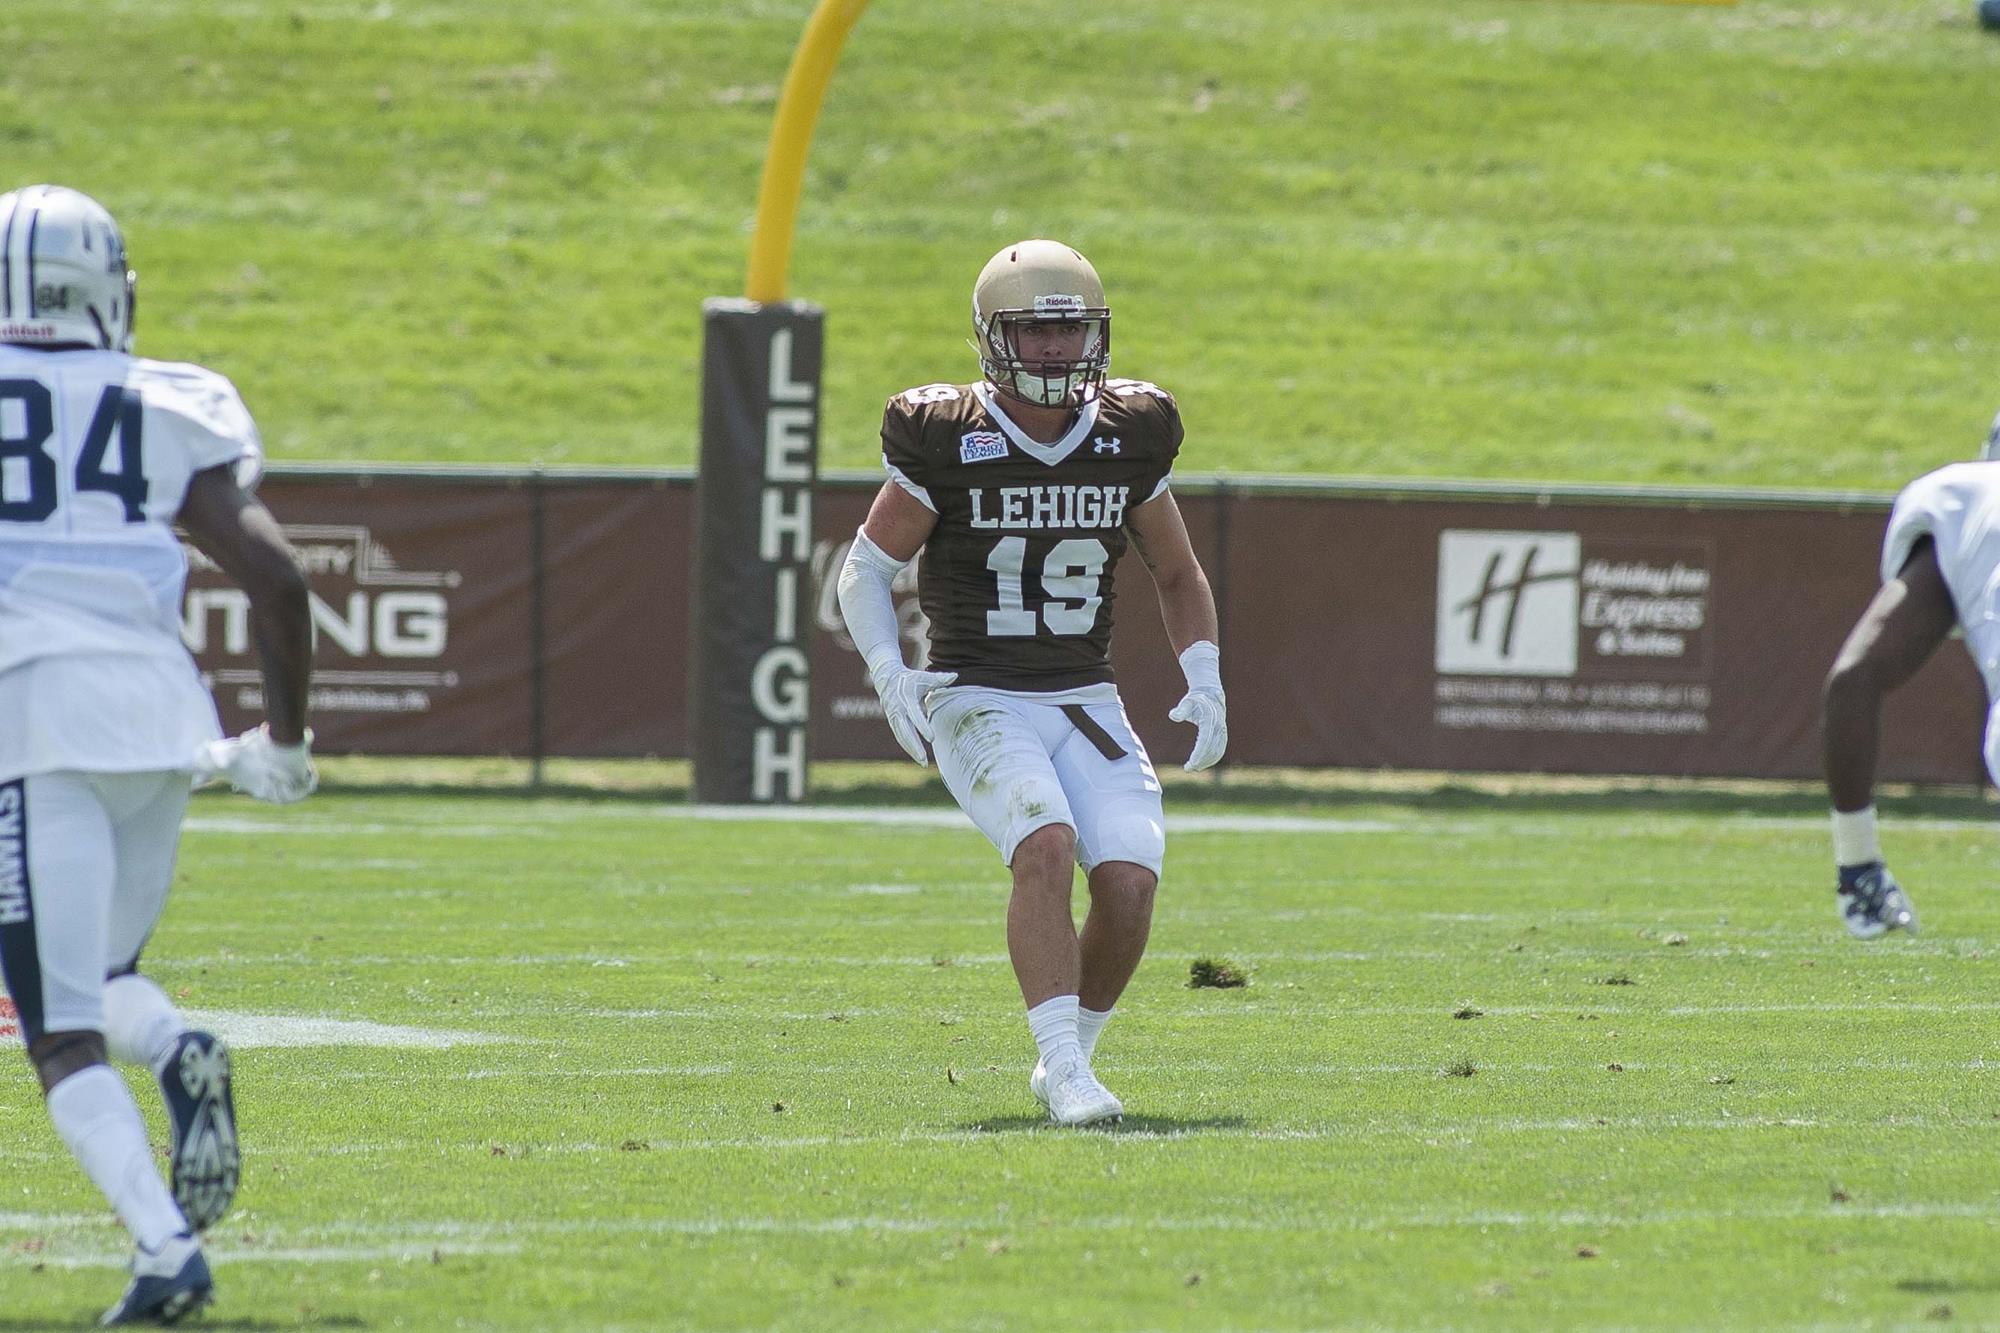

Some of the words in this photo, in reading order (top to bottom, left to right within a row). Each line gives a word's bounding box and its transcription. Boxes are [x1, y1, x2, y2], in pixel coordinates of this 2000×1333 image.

[1045, 298, 1073, 306] Riddell
[0, 379, 149, 523] 84
[964, 440, 1004, 456] PATRIOT
[969, 485, 1129, 529] LEHIGH
[751, 328, 815, 800] LEHIGH
[986, 536, 1109, 636] 19
[0, 786, 28, 922] HAWKS
